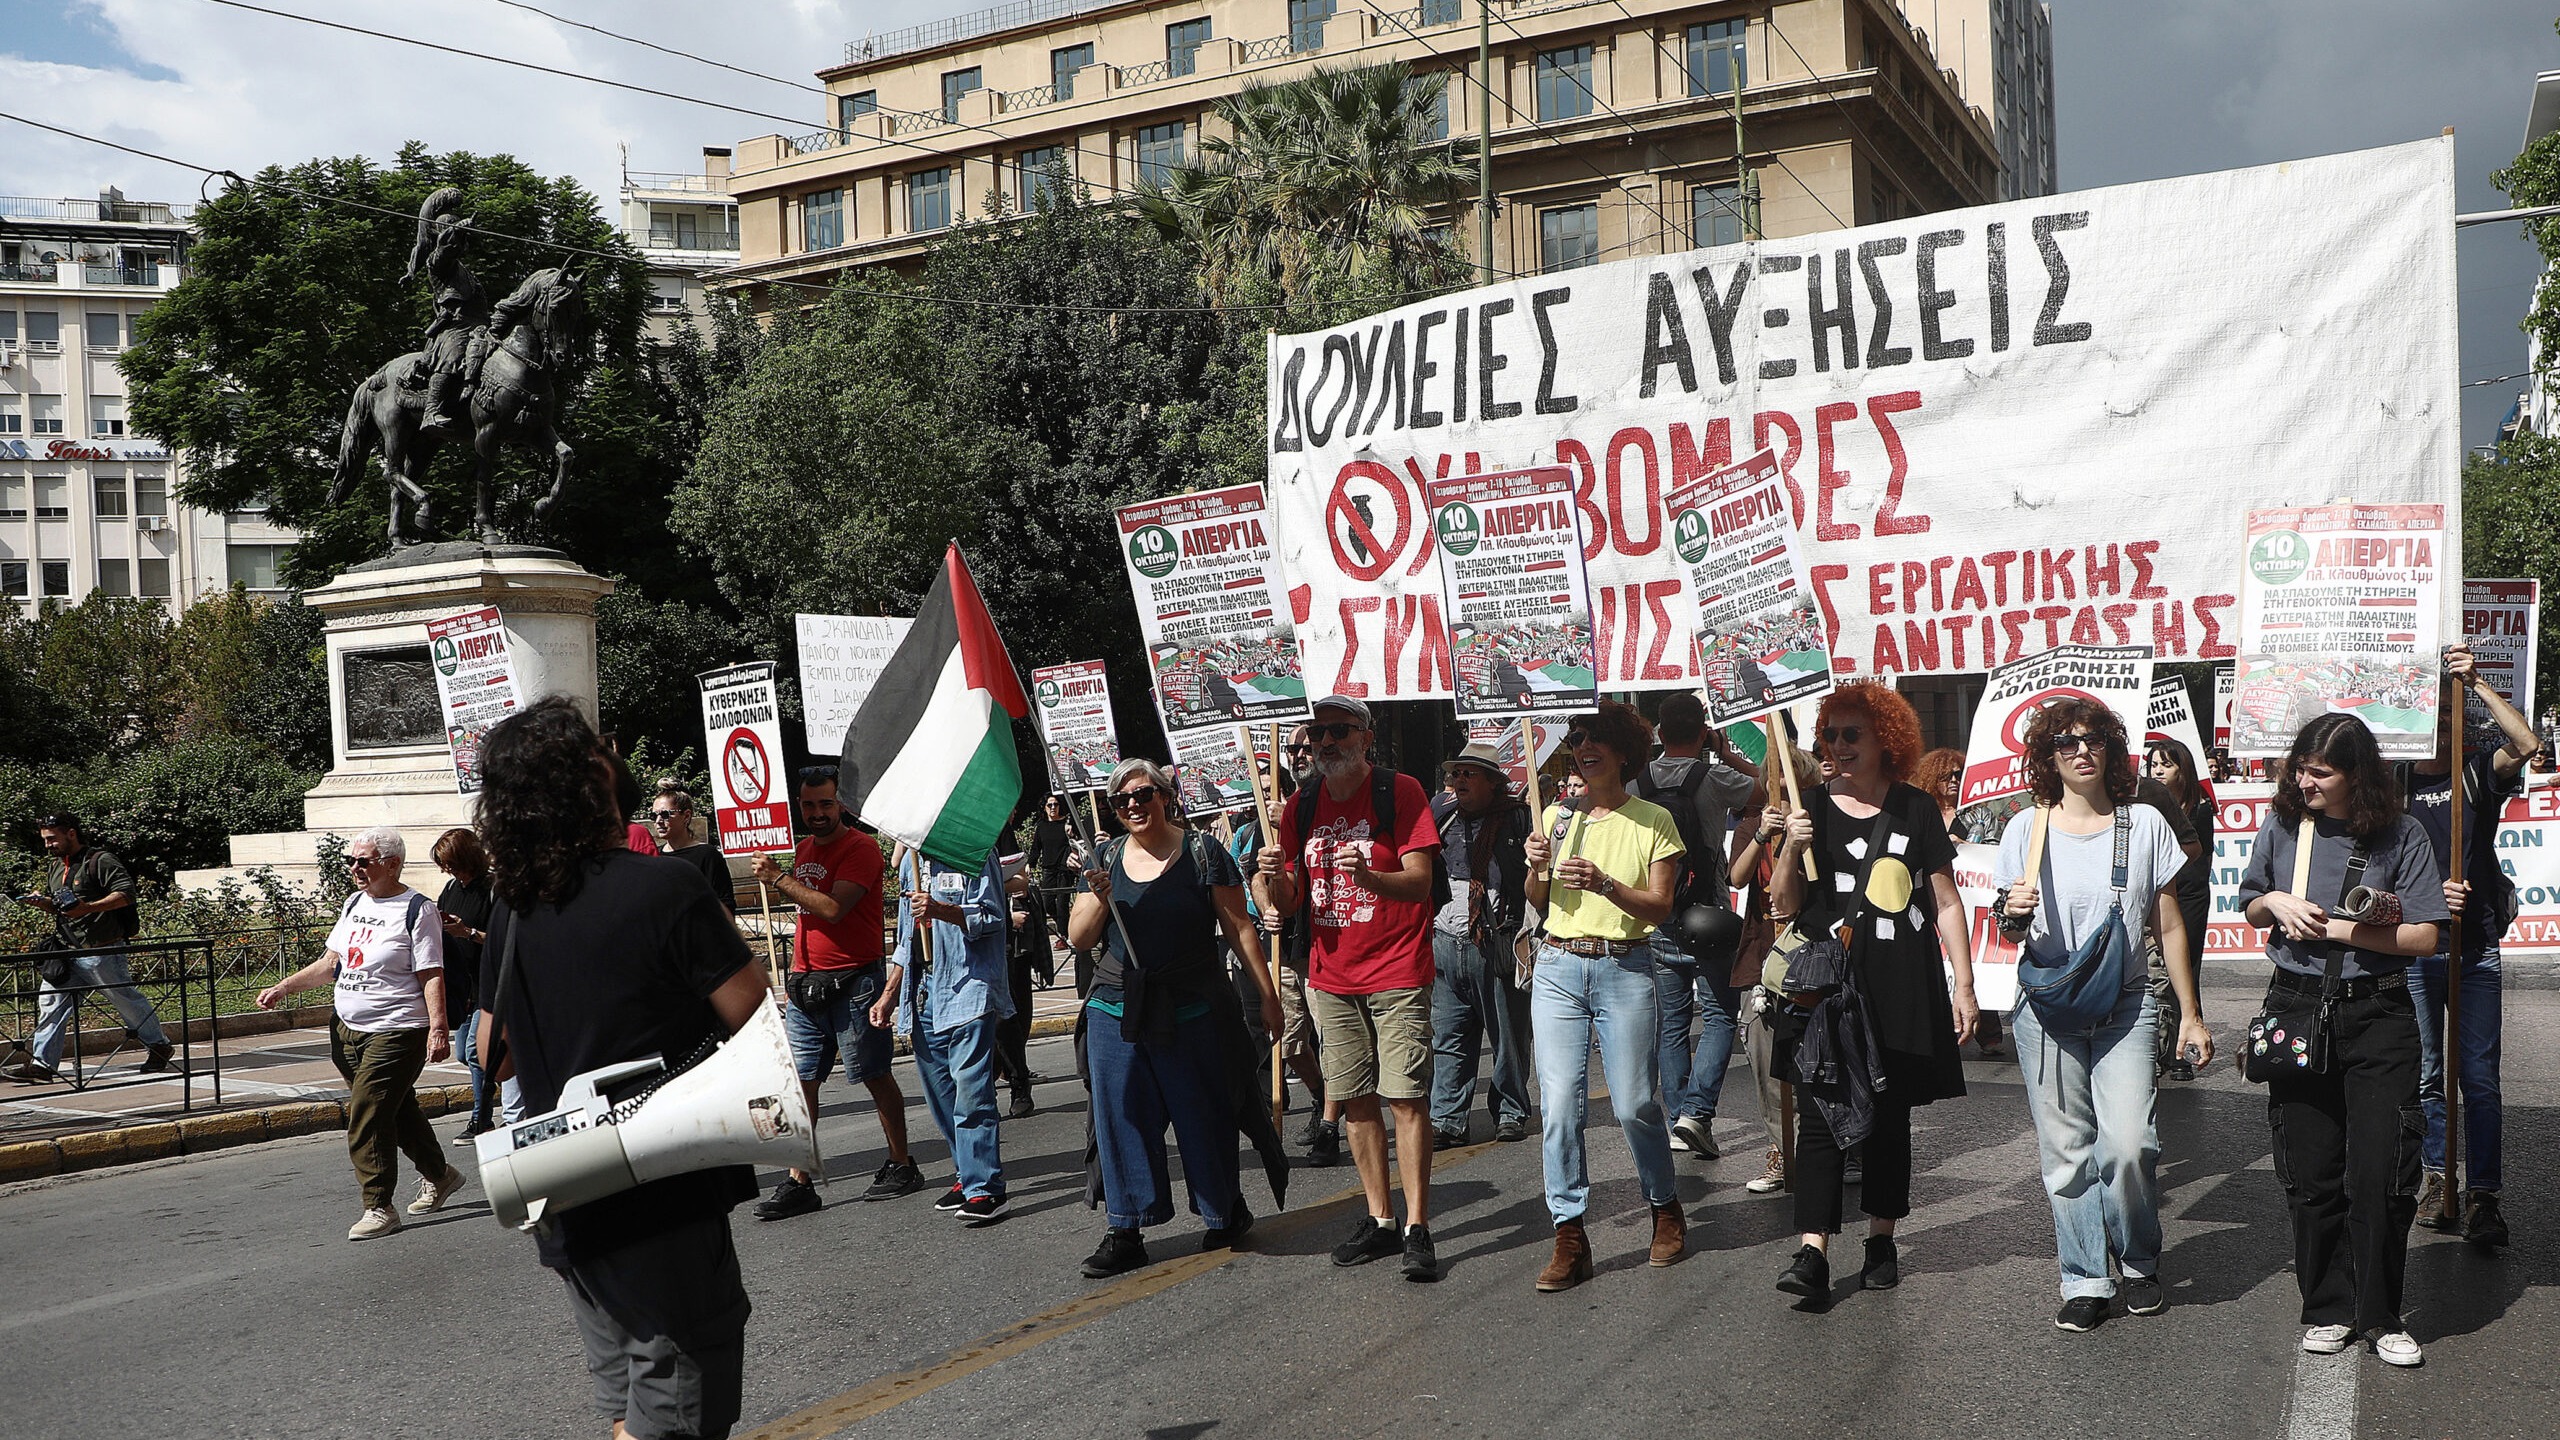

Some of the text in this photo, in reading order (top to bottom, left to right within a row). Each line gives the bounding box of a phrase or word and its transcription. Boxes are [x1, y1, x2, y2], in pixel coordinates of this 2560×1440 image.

[1275, 211, 2092, 453] ΔΟΥΛΕΙΕΣ ΑΥΞΗΣΕΙΣ
[45, 440, 111, 460] Tours
[1445, 507, 1467, 530] 10
[1485, 500, 1571, 538] ΑΠΕΡΓΙΑ
[1711, 484, 1783, 539] ΑΠΕΡΓΙΑ
[1443, 530, 1477, 543] ΟΚΤΩΒΡΗ
[1679, 514, 1698, 540] 10
[1137, 530, 1163, 554] 10
[1182, 519, 1267, 558] ΑΠΕΡΓΙΑ
[1480, 532, 1573, 551] Πλ. Κλαυθμώνος 1μμ
[2262, 534, 2294, 558] 10
[1135, 551, 1176, 566] ΟΚΤΩΒΡΗ
[1180, 550, 1270, 571] Πλ. Κλαυθμώνος 1μμ
[1455, 550, 1564, 570] ΝΑ ΣΠΑΣΟΥΜΕ ΤΗ ΣΤΗΡΙΞΗ
[1702, 535, 1784, 574] ΣΠΑΣΟΥΜΕ ΣΤΗΡΙΞΗ
[2314, 538, 2432, 567] ΑΠΕΡΓΙΑ
[1456, 564, 1523, 579] ΣΤΗ ΓΕΝΟΚΤΟΝΙΑ
[1747, 558, 1790, 581] ΠΑΛΑΙΣΤΙΝΗ
[2254, 560, 2304, 571] ΟΚΤΩΒΡΗ
[1151, 566, 1262, 592] ΝΑ ΣΠΑΣΟΥΜΕ ΤΗ ΣΤΗΡΙΞΗ
[1458, 574, 1568, 593] ΛΕΥΤΕΡΙΑ ΣΤΗΝ ΠΑΛΑΙΣΤΙΝΗ
[1869, 541, 2168, 614] ΕΡΓΑΤΙΚΗΣ
[2307, 569, 2432, 584] Πλ. Κλαυθμώνος 1μμ
[1153, 582, 1223, 601] ΣΤΗ ΓΕΝΟΚΤΟΝΙΑ
[1157, 589, 1268, 614] ΛΕΥΤΕΡΙΑ ΣΤΗΝ ΠΑΛΑΙΣΤΙΝΗ
[2265, 587, 2416, 598] ΝΑ ΣΠΑΣΟΥΜΕ ΤΗ ΣΤΗΡΙΞΗ
[1462, 596, 1548, 612] ΔΟΥΛΕΙΕΣ ΑΥΞΗΣΕΙΣ
[1703, 585, 1776, 620] ΔΟΥΛΕΙΕΣ ΑΥΞΗΣΕΙΣ
[2264, 597, 2356, 608] ΣΤΗ ΓΕΝΟΚΤΟΝΙΑ
[1162, 612, 1250, 633] ΔΟΥΛΕΙΕΣ ΑΥΞΗΣΕΙΣ
[2262, 611, 2416, 622] ΛΕΥΤΕΡΙΑ ΣΤΗΝ ΠΑΛΑΙΣΤΙΝΗ
[2372, 620, 2382, 628] TO
[798, 618, 813, 637] ΤΑ
[1872, 595, 2236, 675] ΑΝΤΙΣΤΑΣΗΣ
[2262, 632, 2384, 643] ΔΟΥΛΕΙΕΣ ΑΥΞΗΣΕΙΣ
[437, 640, 450, 658] 10
[458, 632, 505, 662] ΑΠΕΡΓΙΑ
[800, 642, 840, 661] ΠΑΝΤΟΥ
[2279, 643, 2318, 652] ΒΟΜΒΕΣ
[2322, 642, 2338, 651] ΚΑΙ
[2341, 643, 2414, 653] ΕΞΟΠΛΙΣΜΟΥΣ
[2509, 639, 2528, 649] 1μμ
[2000, 662, 2135, 688] ΚΥΒΕΡΝΗΣΗ
[805, 685, 821, 702] ΤΗ
[1041, 682, 1054, 695] 10
[1063, 678, 1104, 698] ΑΠΕΡΓΙΑ
[1990, 675, 2140, 702] ΔΟΛΟΦΟΝΩΝ
[709, 687, 767, 711] ΚΥΒΕΡΝΗΣΗ
[710, 705, 772, 730] ΔΟΛΟΦΟΝΩΝ
[735, 807, 772, 828] ΝΑ ΤΗΝ
[723, 827, 790, 850] ΑΝΑΤΡΕΨΟΥΜΕ
[352, 915, 386, 927] GAZA
